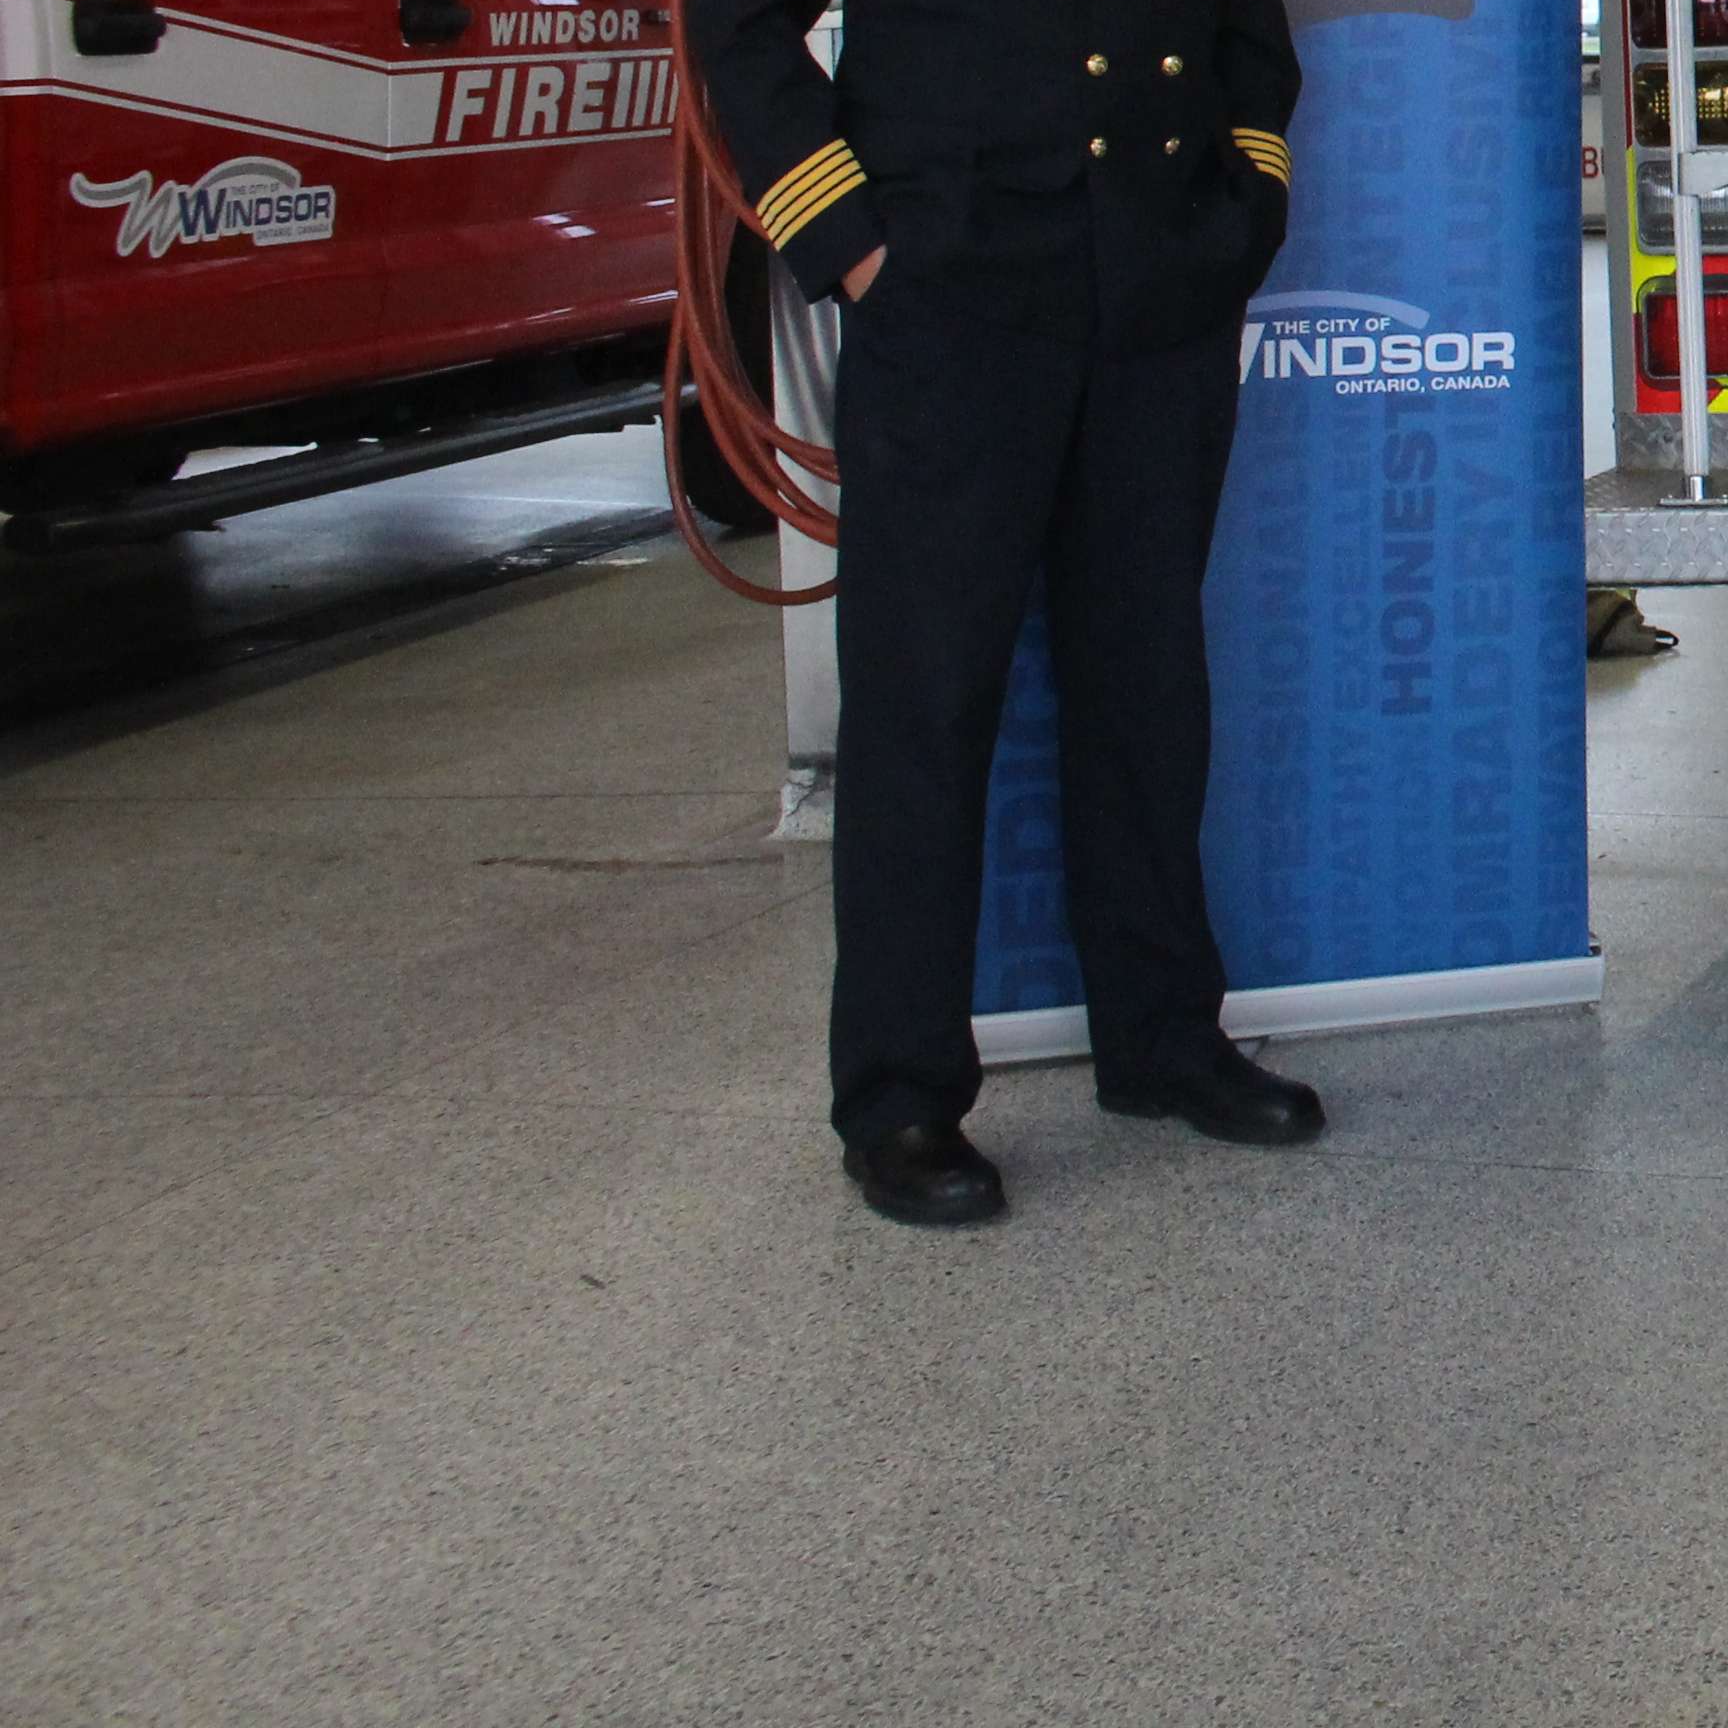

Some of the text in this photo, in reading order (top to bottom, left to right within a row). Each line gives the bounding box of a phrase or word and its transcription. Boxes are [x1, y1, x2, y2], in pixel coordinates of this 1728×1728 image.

[489, 8, 640, 47] WINDSOR
[446, 61, 611, 142] FIRE
[178, 187, 331, 237] WINDSOR
[1273, 317, 1391, 335] THE CITY OF
[1239, 322, 1516, 384] INDSOR
[1335, 375, 1510, 394] ONTARIO, CANADA
